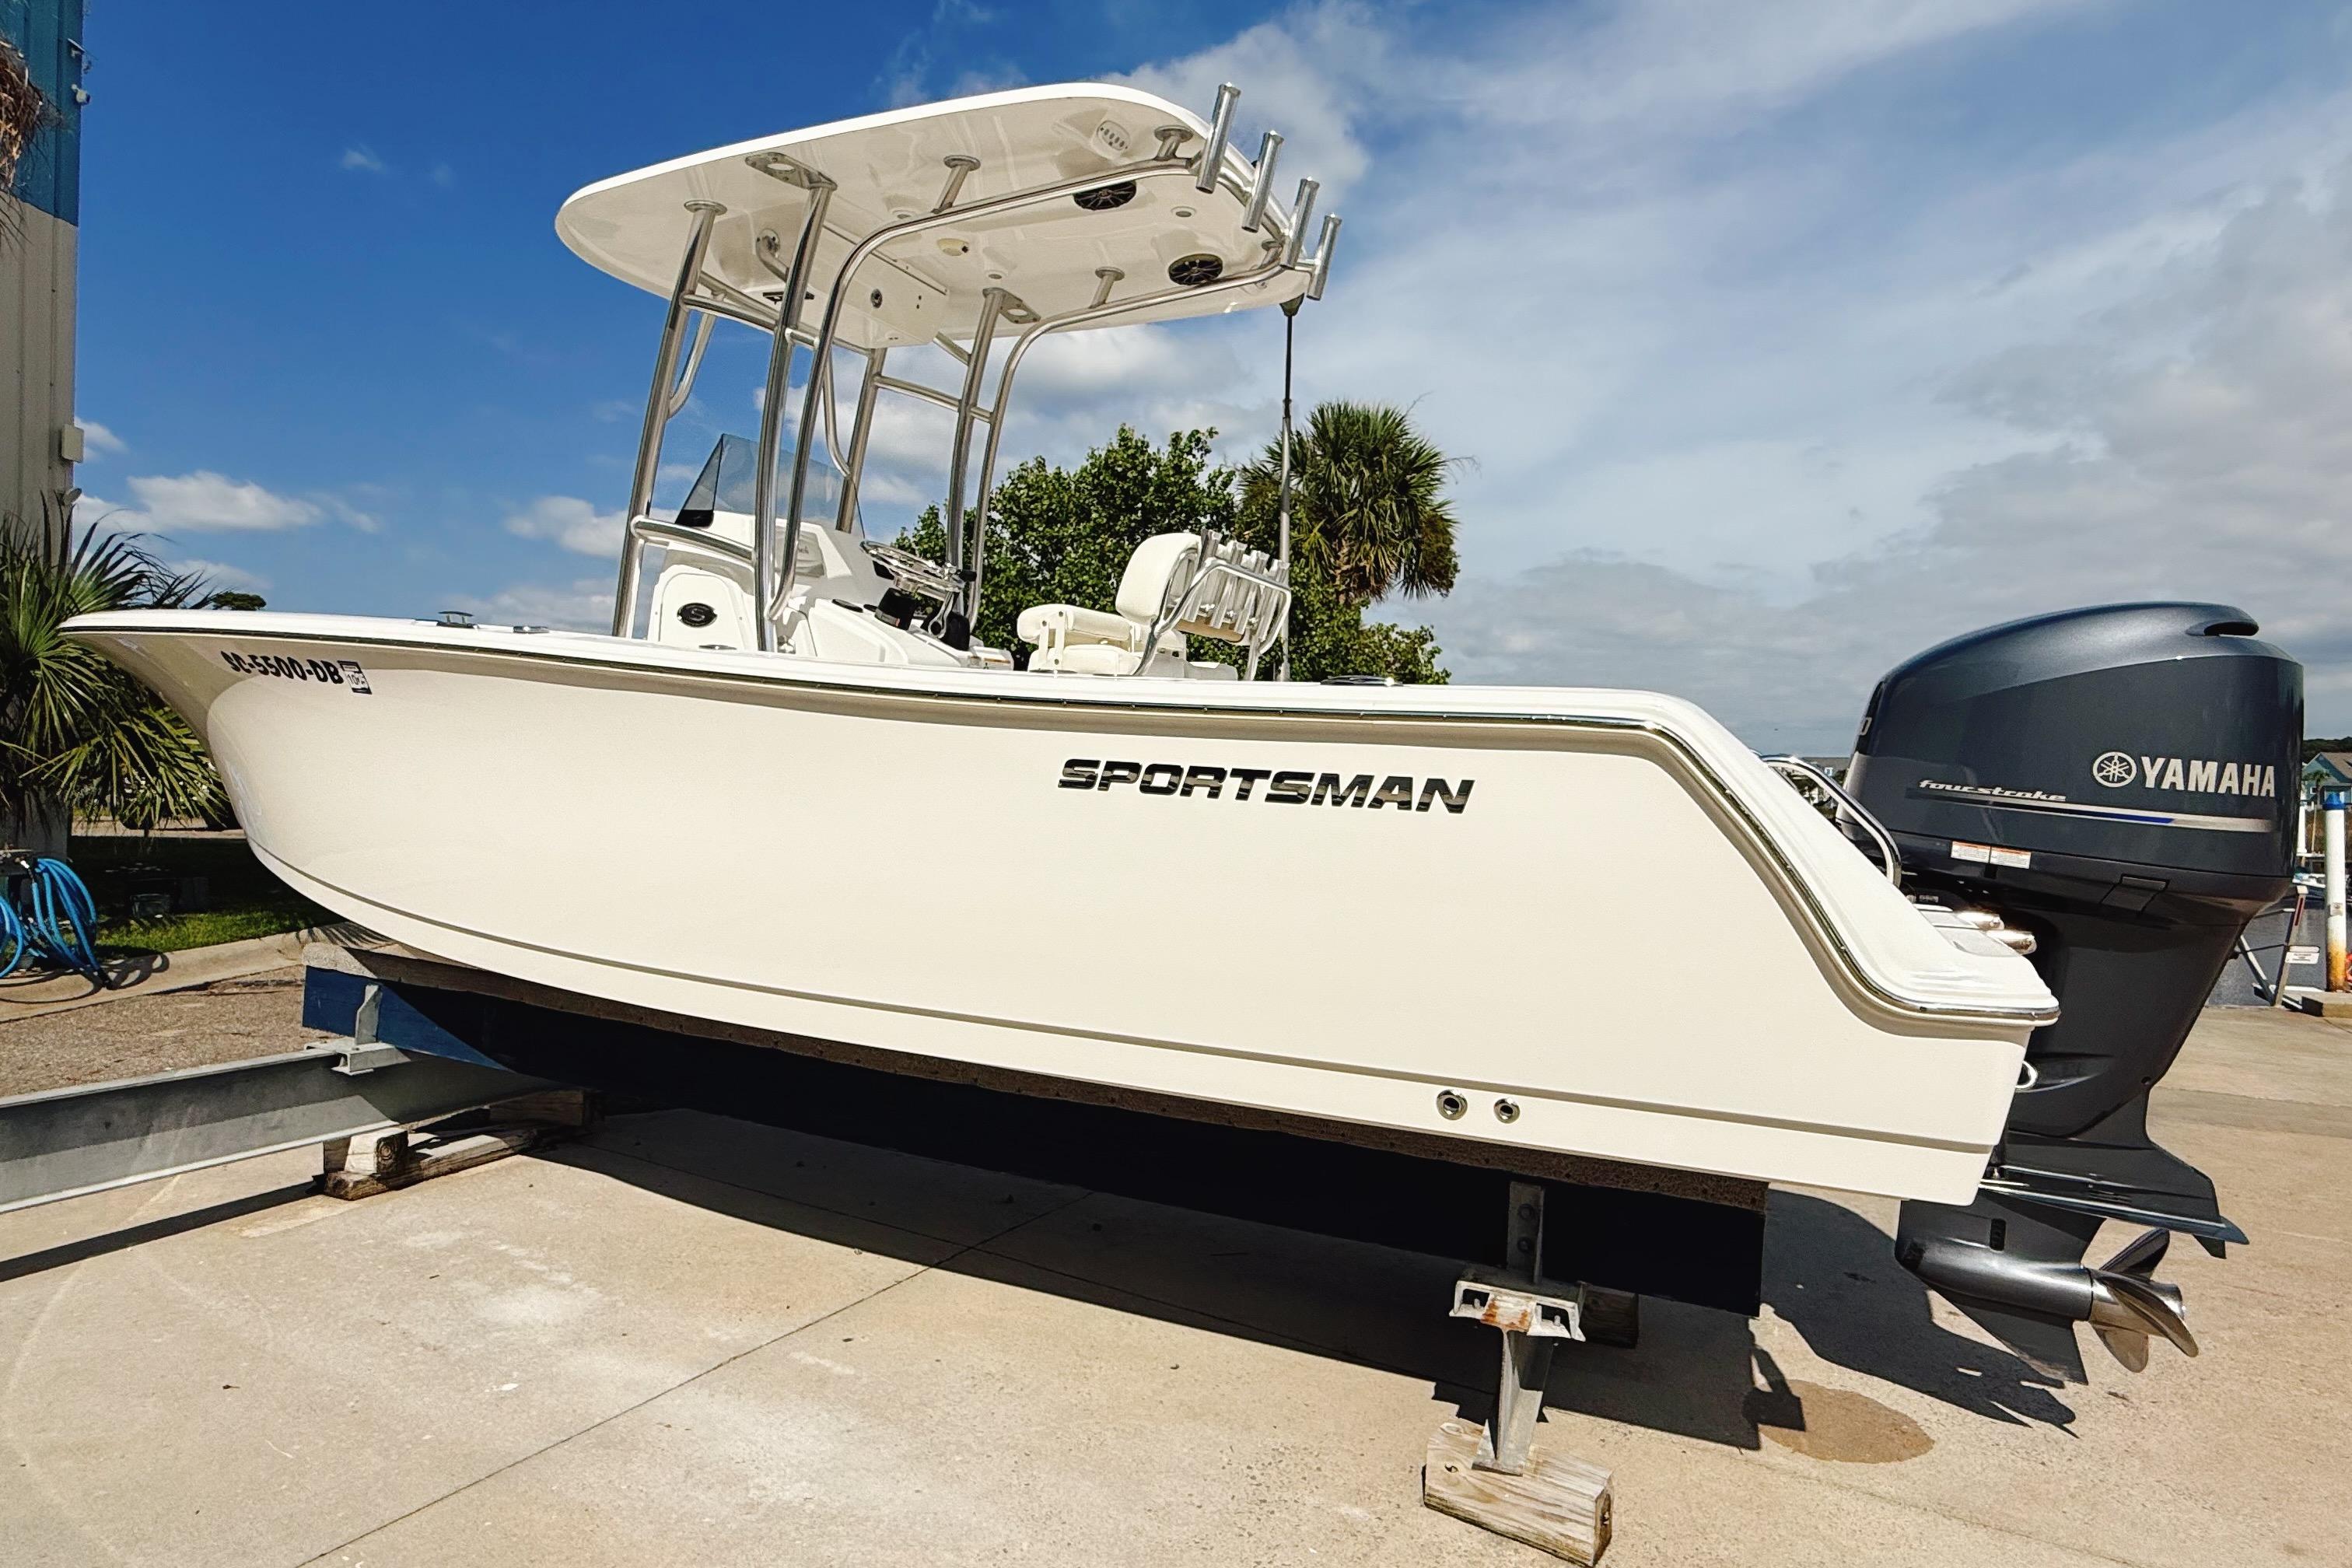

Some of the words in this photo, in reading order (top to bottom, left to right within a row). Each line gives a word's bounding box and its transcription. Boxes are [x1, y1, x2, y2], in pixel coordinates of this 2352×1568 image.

[220, 650, 344, 684] SC-5500-DB
[1058, 758, 1475, 814] SPORTSMAN
[2140, 756, 2276, 797] YAMAHA
